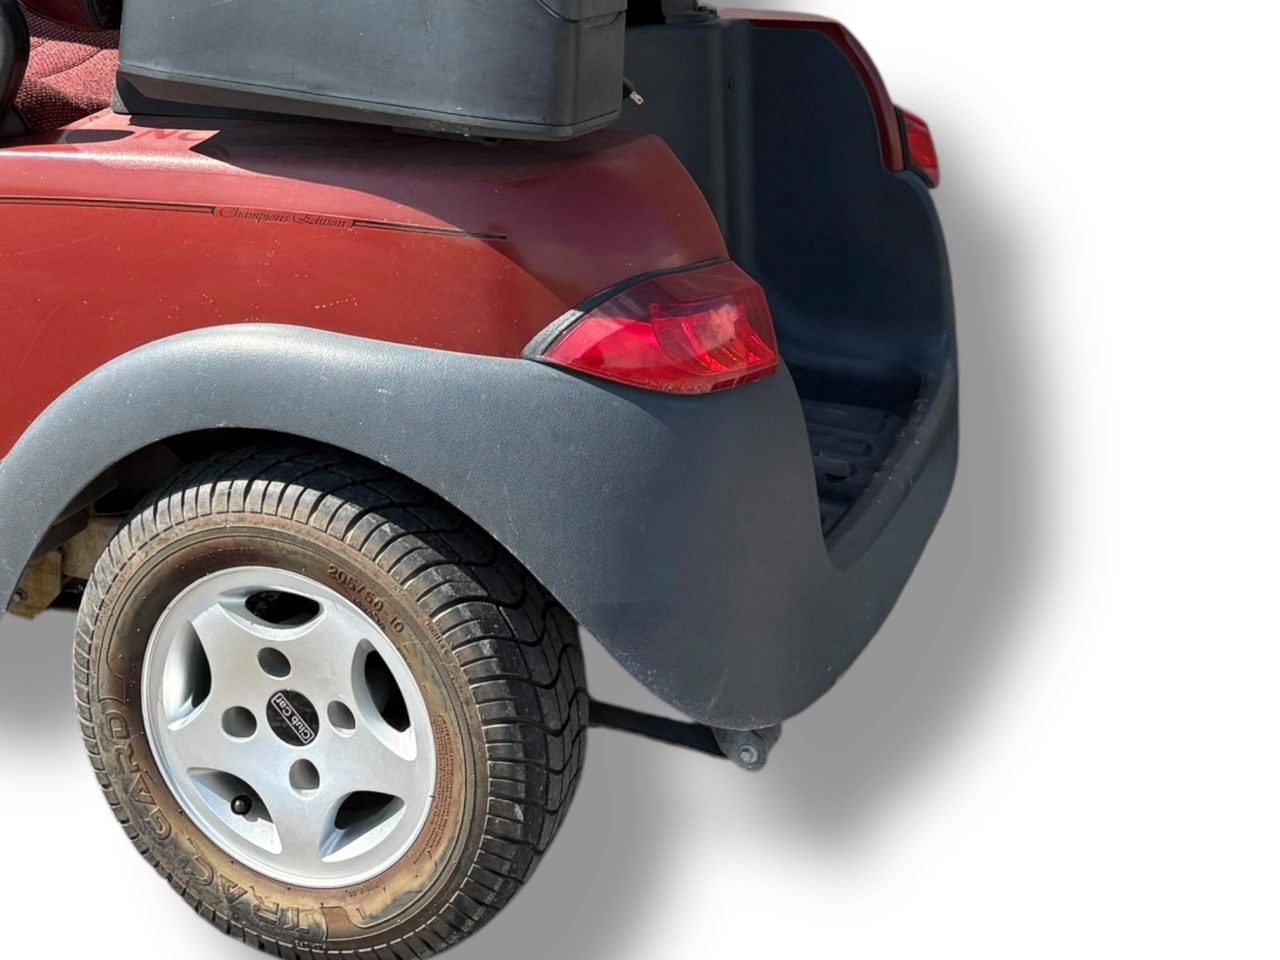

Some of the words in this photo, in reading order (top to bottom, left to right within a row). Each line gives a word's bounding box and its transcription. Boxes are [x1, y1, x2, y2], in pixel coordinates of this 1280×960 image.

[220, 206, 289, 223] Champions
[293, 213, 347, 228] Edition
[327, 563, 405, 633] 205/50-10
[275, 698, 292, 717] Car
[291, 716, 310, 739] Club
